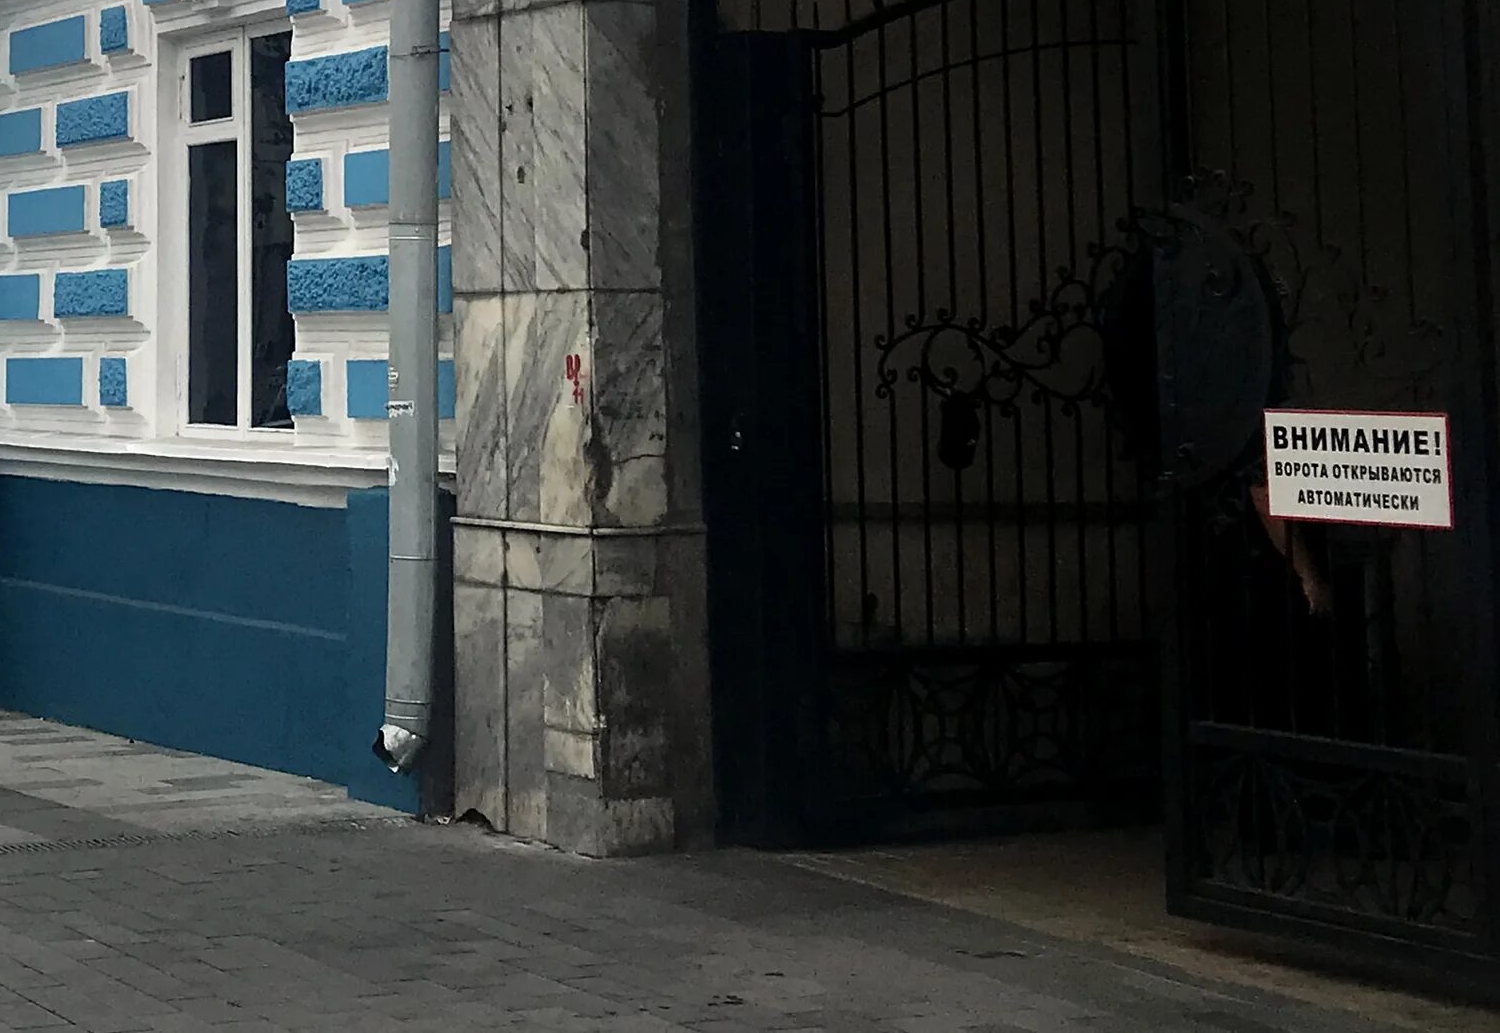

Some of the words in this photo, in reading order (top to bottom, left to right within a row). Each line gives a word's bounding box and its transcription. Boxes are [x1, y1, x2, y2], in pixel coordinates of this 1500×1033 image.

[1272, 425, 1442, 456] ВНИМАНИЕ!
[1274, 461, 1329, 479] ВОРОТА
[1332, 463, 1442, 484] ОТКРЫВАЮТСЯ
[1297, 489, 1420, 511] АВТОМАТИЧЕСКИ
